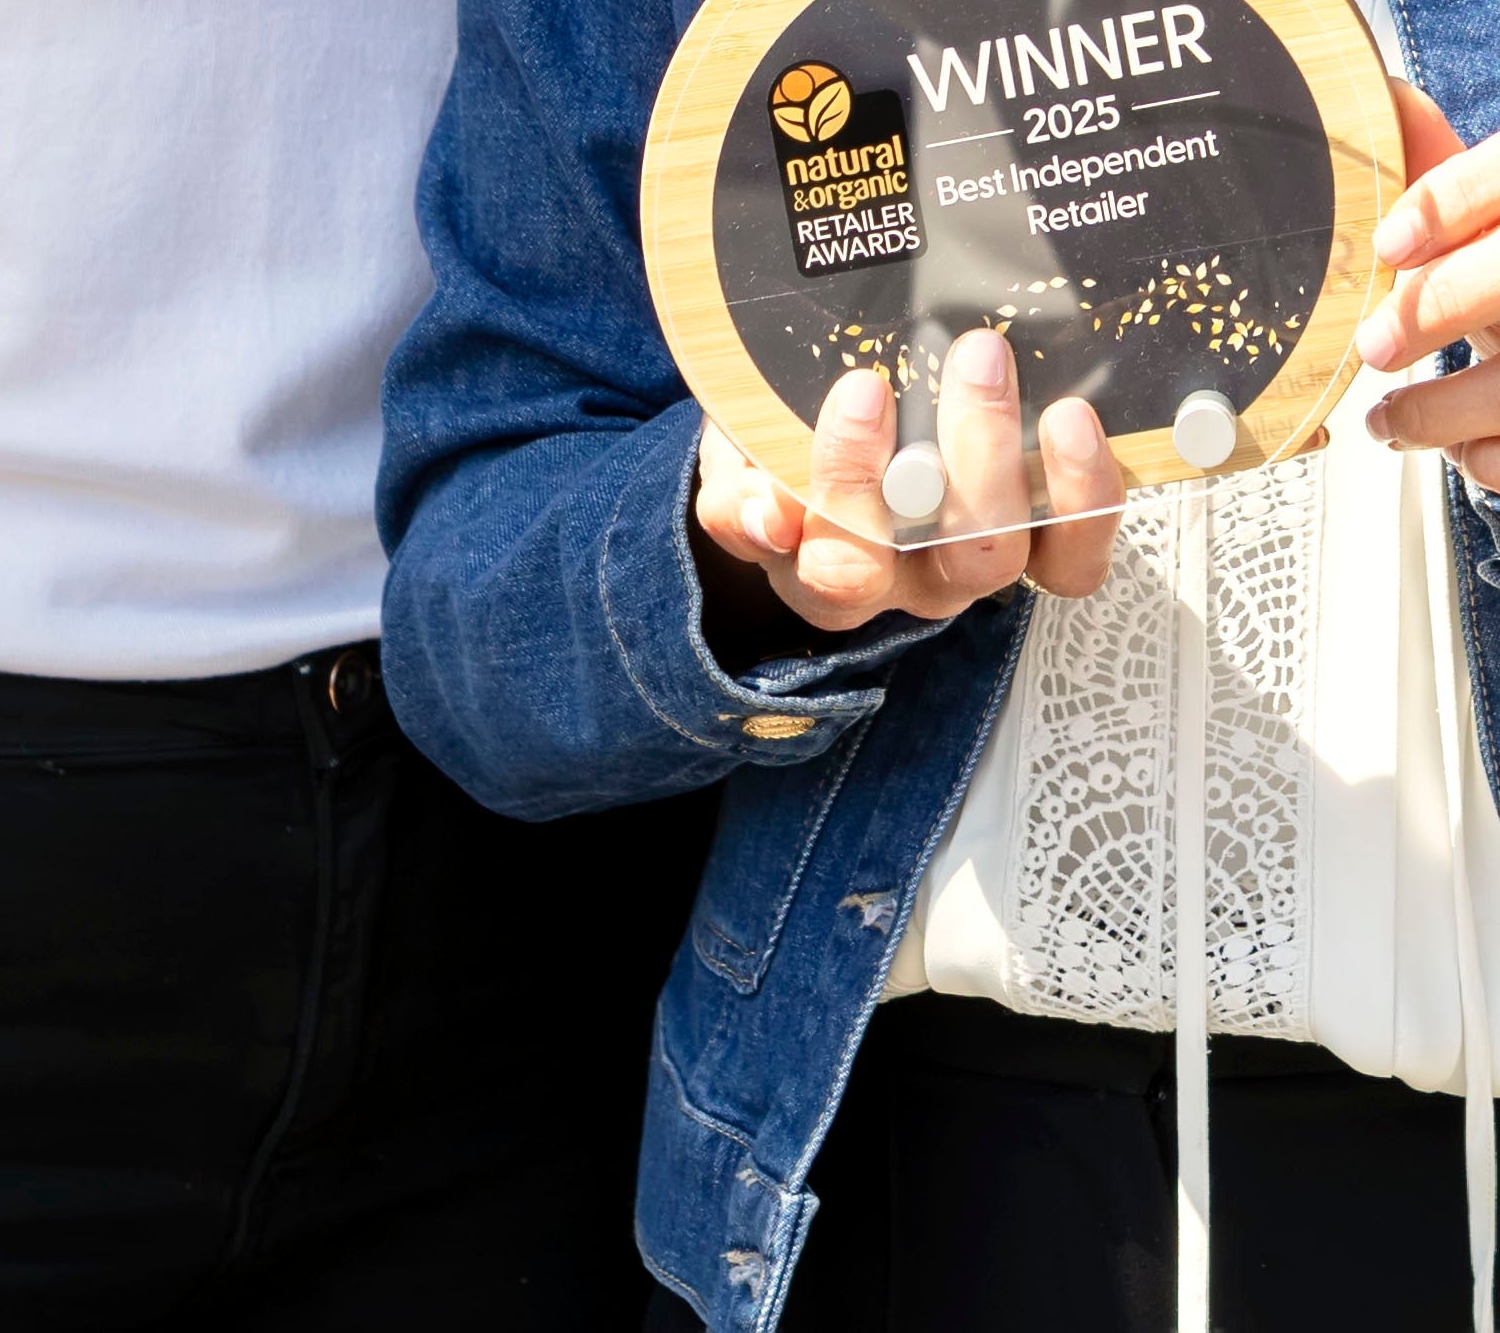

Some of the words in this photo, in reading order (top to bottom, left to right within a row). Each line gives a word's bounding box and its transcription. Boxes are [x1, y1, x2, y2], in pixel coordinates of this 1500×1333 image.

[907, 4, 1212, 112] WINNER
[1023, 95, 1120, 144] 2025
[786, 135, 904, 185] natural
[935, 169, 1007, 206] Best
[1010, 130, 1220, 186] Independent
[793, 169, 908, 212] &organic
[1026, 190, 1149, 235] Retailer
[797, 202, 916, 244] RETAILER
[805, 226, 921, 269] AWARDS
